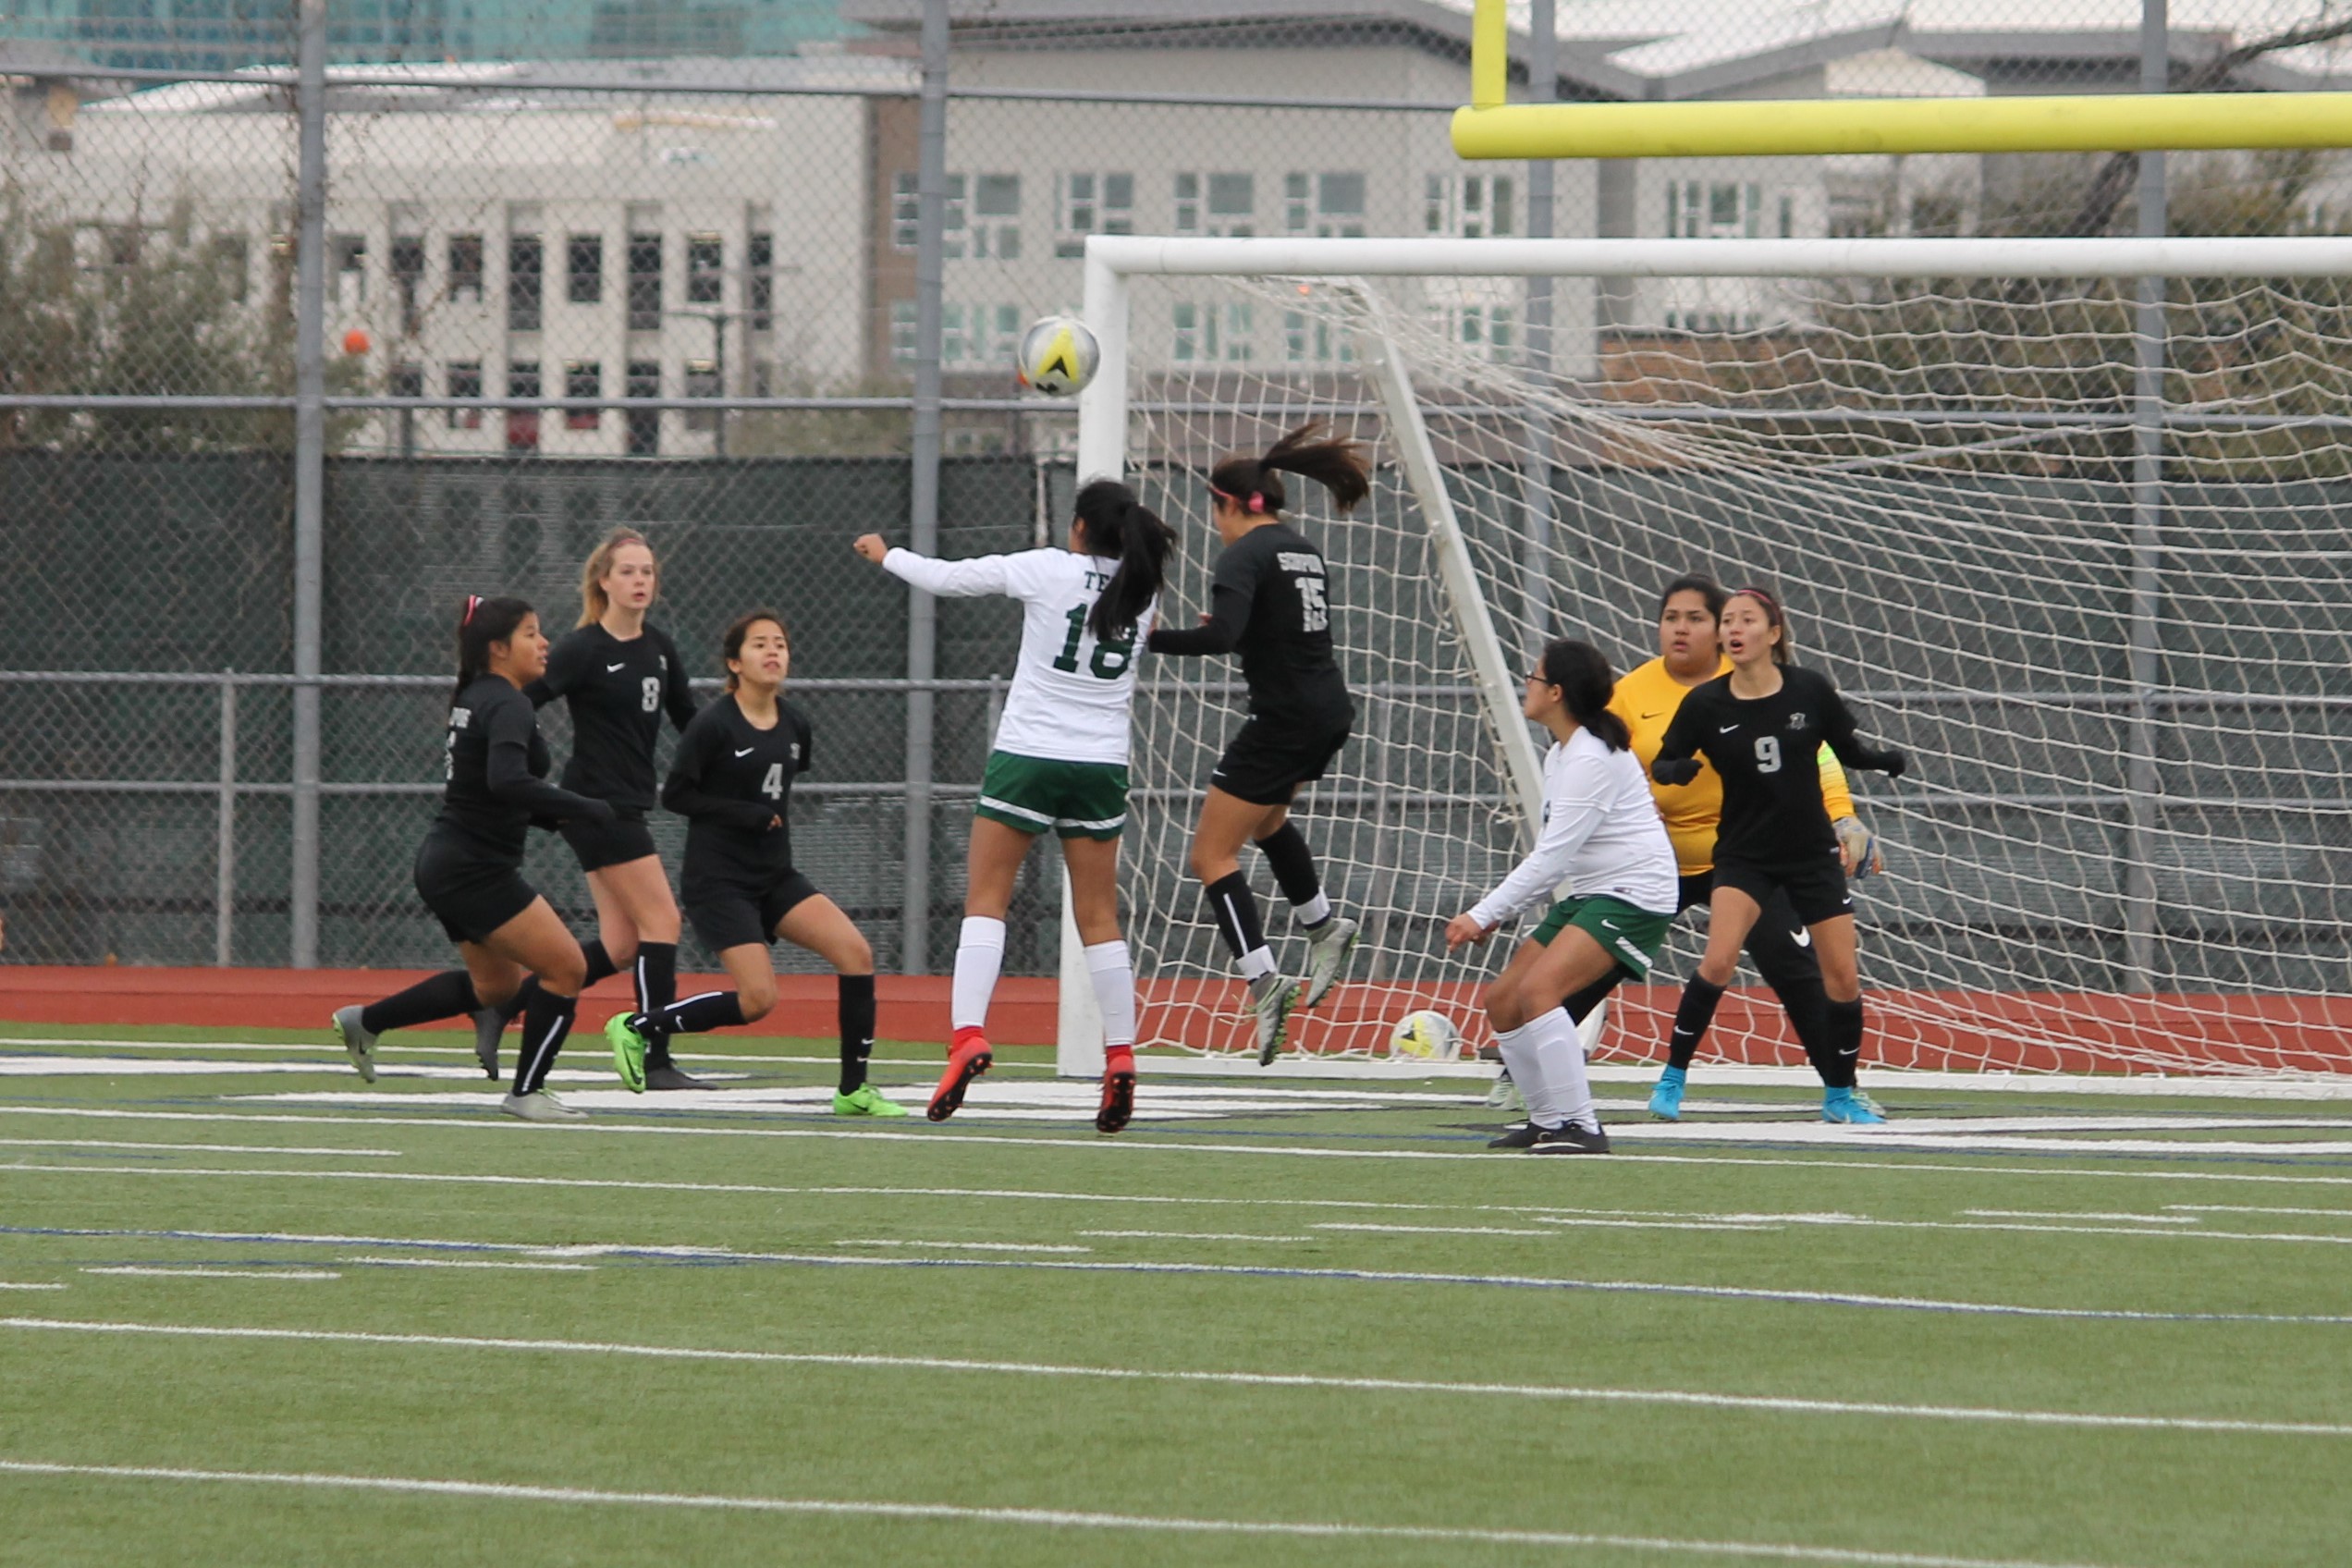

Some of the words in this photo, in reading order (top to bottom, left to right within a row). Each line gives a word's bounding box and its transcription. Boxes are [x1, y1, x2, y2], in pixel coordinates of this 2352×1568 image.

[1294, 577, 1328, 632] 15
[1053, 603, 1138, 680] 18
[642, 676, 660, 712] 8
[1754, 735, 1782, 773] 9
[761, 763, 783, 801] 4
